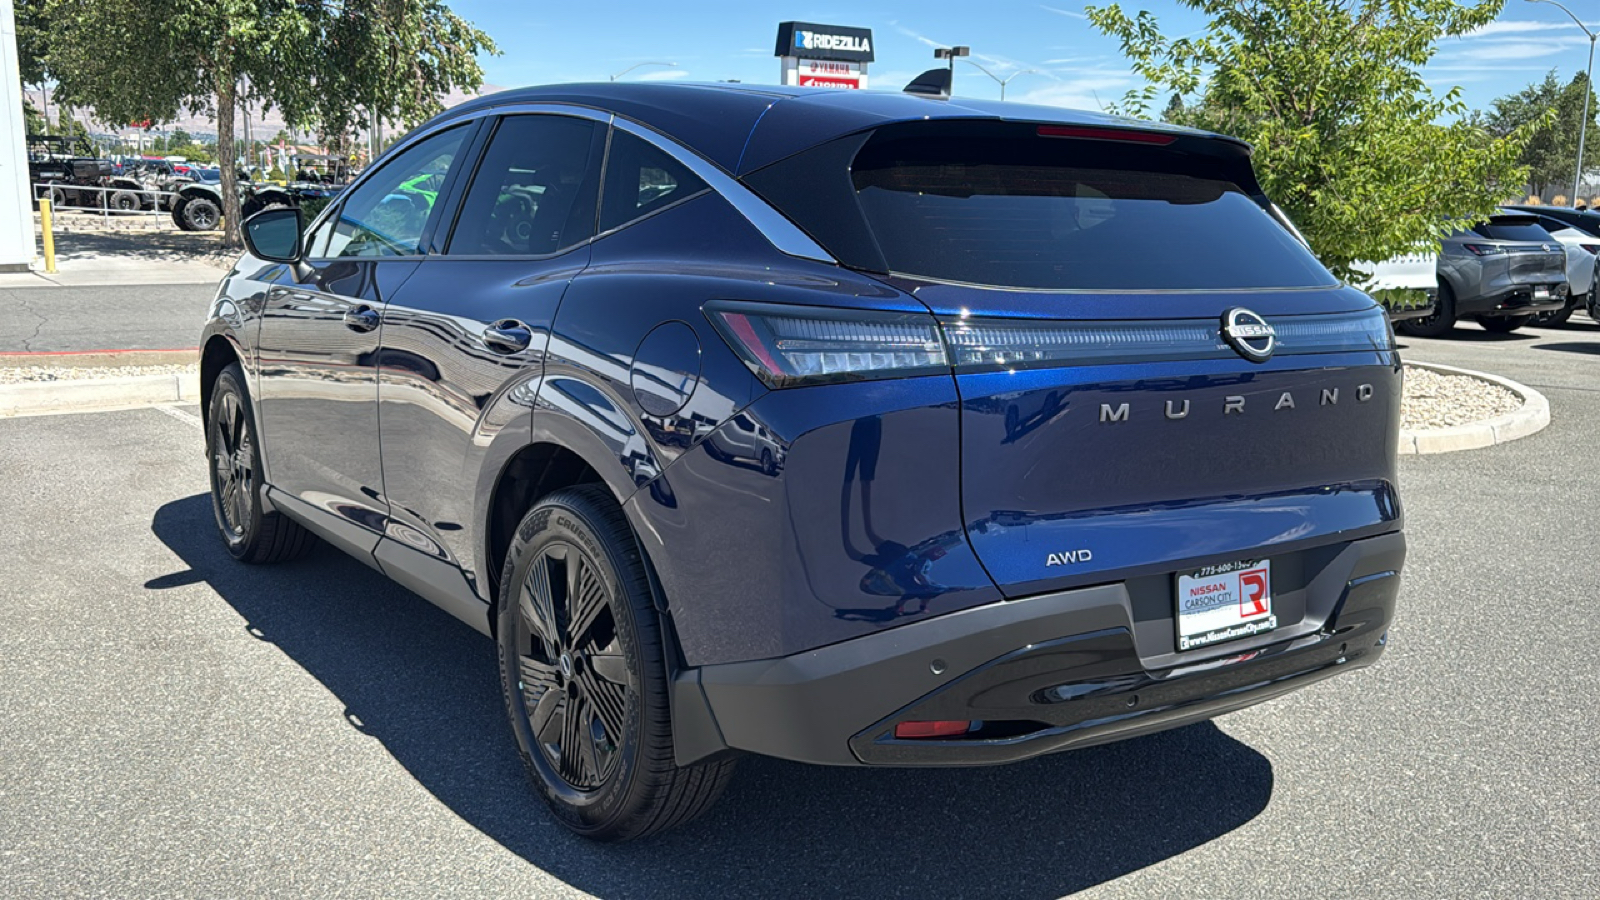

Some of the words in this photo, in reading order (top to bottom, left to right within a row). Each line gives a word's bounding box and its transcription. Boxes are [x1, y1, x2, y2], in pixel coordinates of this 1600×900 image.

[813, 33, 870, 51] RIDEZILLA
[819, 62, 850, 75] YAMAHA
[1234, 324, 1275, 336] NISSAN
[1099, 383, 1375, 423] MURANO
[1045, 549, 1092, 567] AWD
[1190, 582, 1226, 596] NISSAN
[1185, 594, 1217, 609] CARSON
[1217, 591, 1232, 603] CITY
